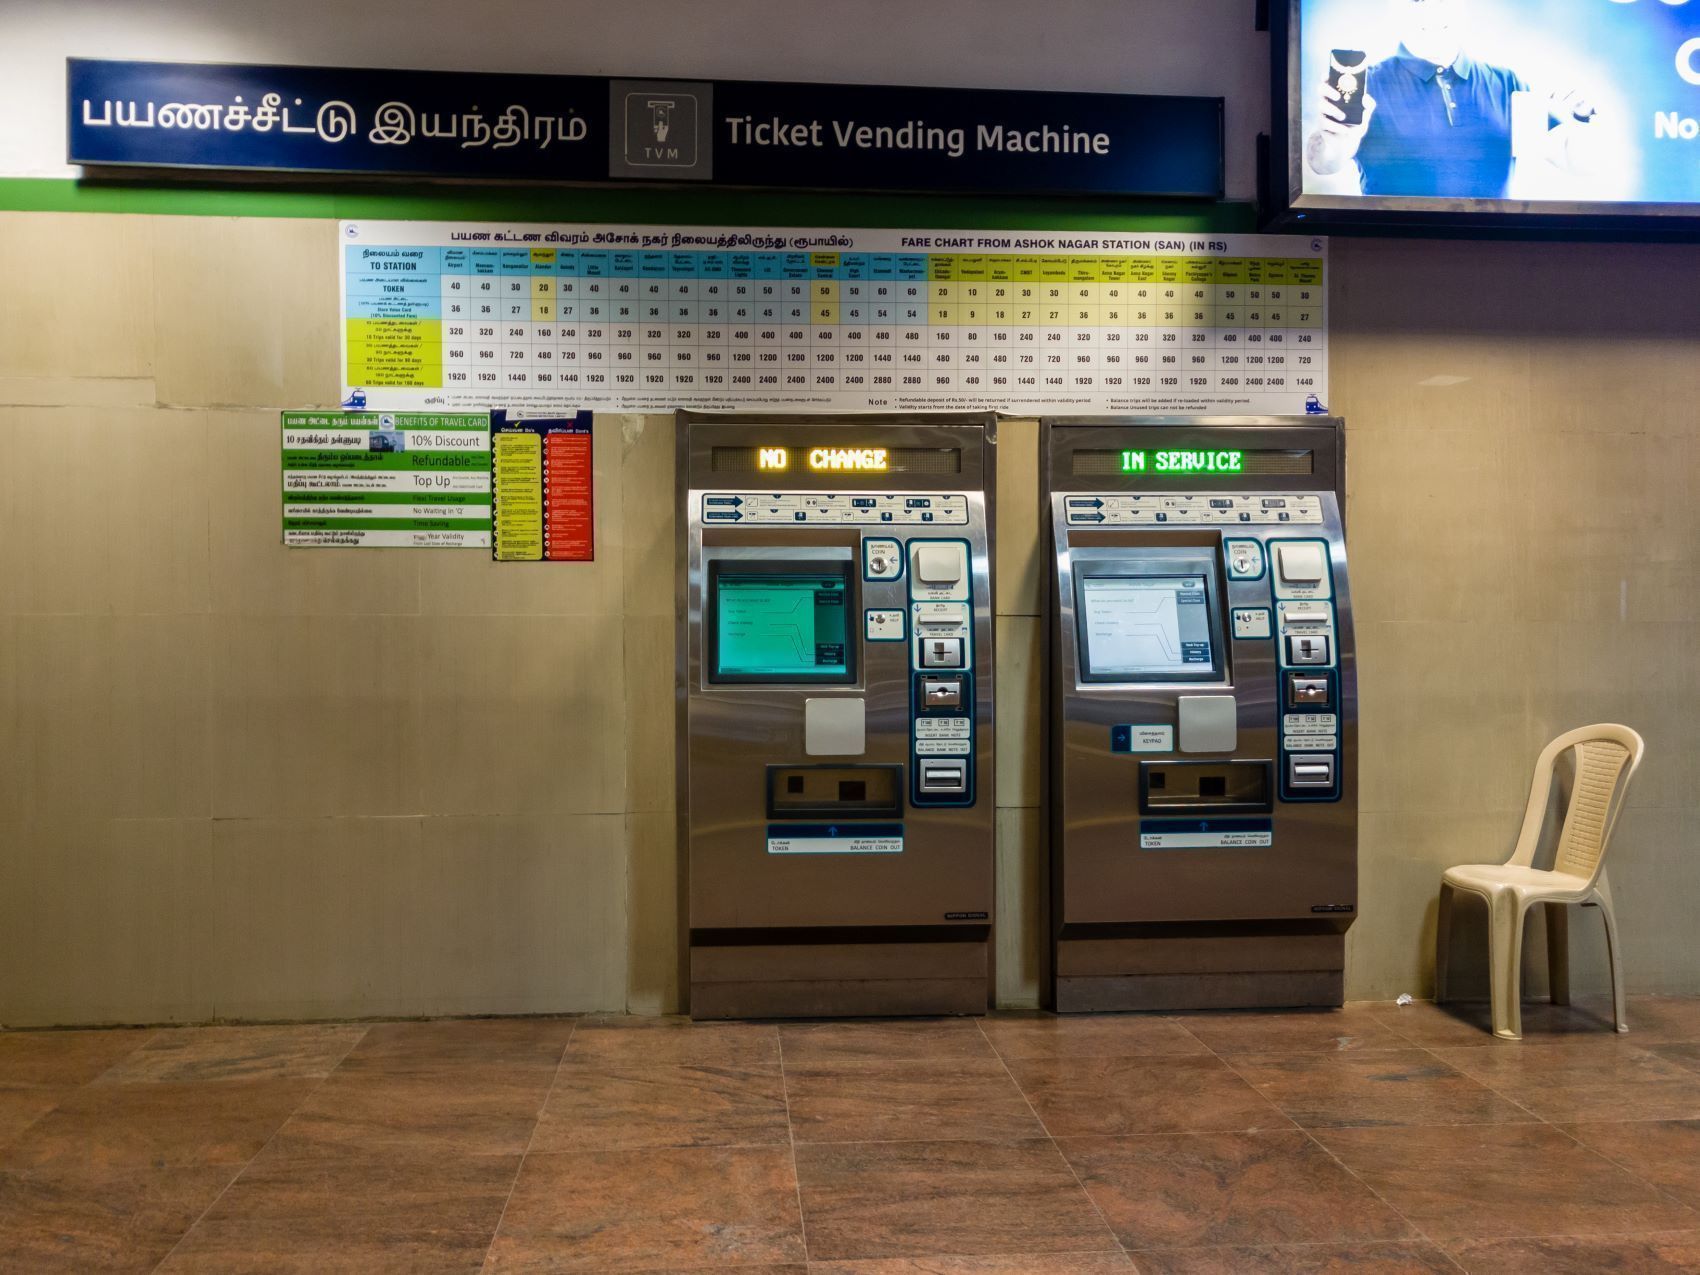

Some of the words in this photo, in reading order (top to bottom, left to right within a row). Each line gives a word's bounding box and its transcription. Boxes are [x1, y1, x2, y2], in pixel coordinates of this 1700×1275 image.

[83, 93, 356, 142] பயணச்சீட்டு
[369, 102, 586, 149] இயந்திரம்
[726, 116, 822, 146] Ticket
[833, 120, 964, 157] Vending
[976, 125, 1110, 154] Machine
[645, 148, 678, 160] TVM
[451, 232, 490, 241] பயண
[495, 231, 540, 242] கட்டண
[545, 231, 588, 244] விவரம்
[593, 232, 638, 244] அசோக்
[642, 232, 668, 247] நகர்
[902, 237, 931, 248] FARE
[935, 237, 974, 248] CHART
[978, 238, 1011, 248] FROM
[1015, 238, 1054, 249] ASHOK
[1058, 239, 1099, 249] NAGAR
[1103, 239, 1150, 250] STATION
[1154, 239, 1185, 252] (SAN)
[1189, 240, 1206, 252] (IN
[1210, 240, 1227, 252] RS)
[384, 262, 416, 270] STATION
[619, 284, 629, 293] 40
[791, 286, 801, 295] 50
[1300, 292, 1310, 300] 30
[512, 306, 520, 314] 27
[708, 308, 718, 317] 36
[907, 310, 917, 318] 54
[480, 328, 494, 336] 320
[588, 330, 602, 338] 320
[706, 330, 721, 339] 320
[818, 332, 832, 340] 400
[968, 332, 977, 340] 80
[562, 352, 576, 360] 720
[677, 353, 691, 361] 960
[759, 353, 778, 362] 1200
[508, 374, 526, 382] 1440
[616, 374, 634, 383] 1920
[732, 376, 751, 384] 2400
[966, 376, 980, 384] 480
[395, 417, 429, 426] BENEFITS
[430, 417, 439, 426] OF
[441, 418, 466, 426] TRAVEL
[468, 418, 487, 427] CARD
[412, 435, 431, 446] 10%
[435, 435, 479, 446] Discount
[412, 455, 470, 466] Refundable
[760, 449, 786, 468] NO
[810, 449, 887, 469] CHANGE
[1122, 452, 1144, 470] IN
[1155, 452, 1241, 470] SERVICE
[414, 476, 432, 489] Top
[436, 475, 450, 490] Up
